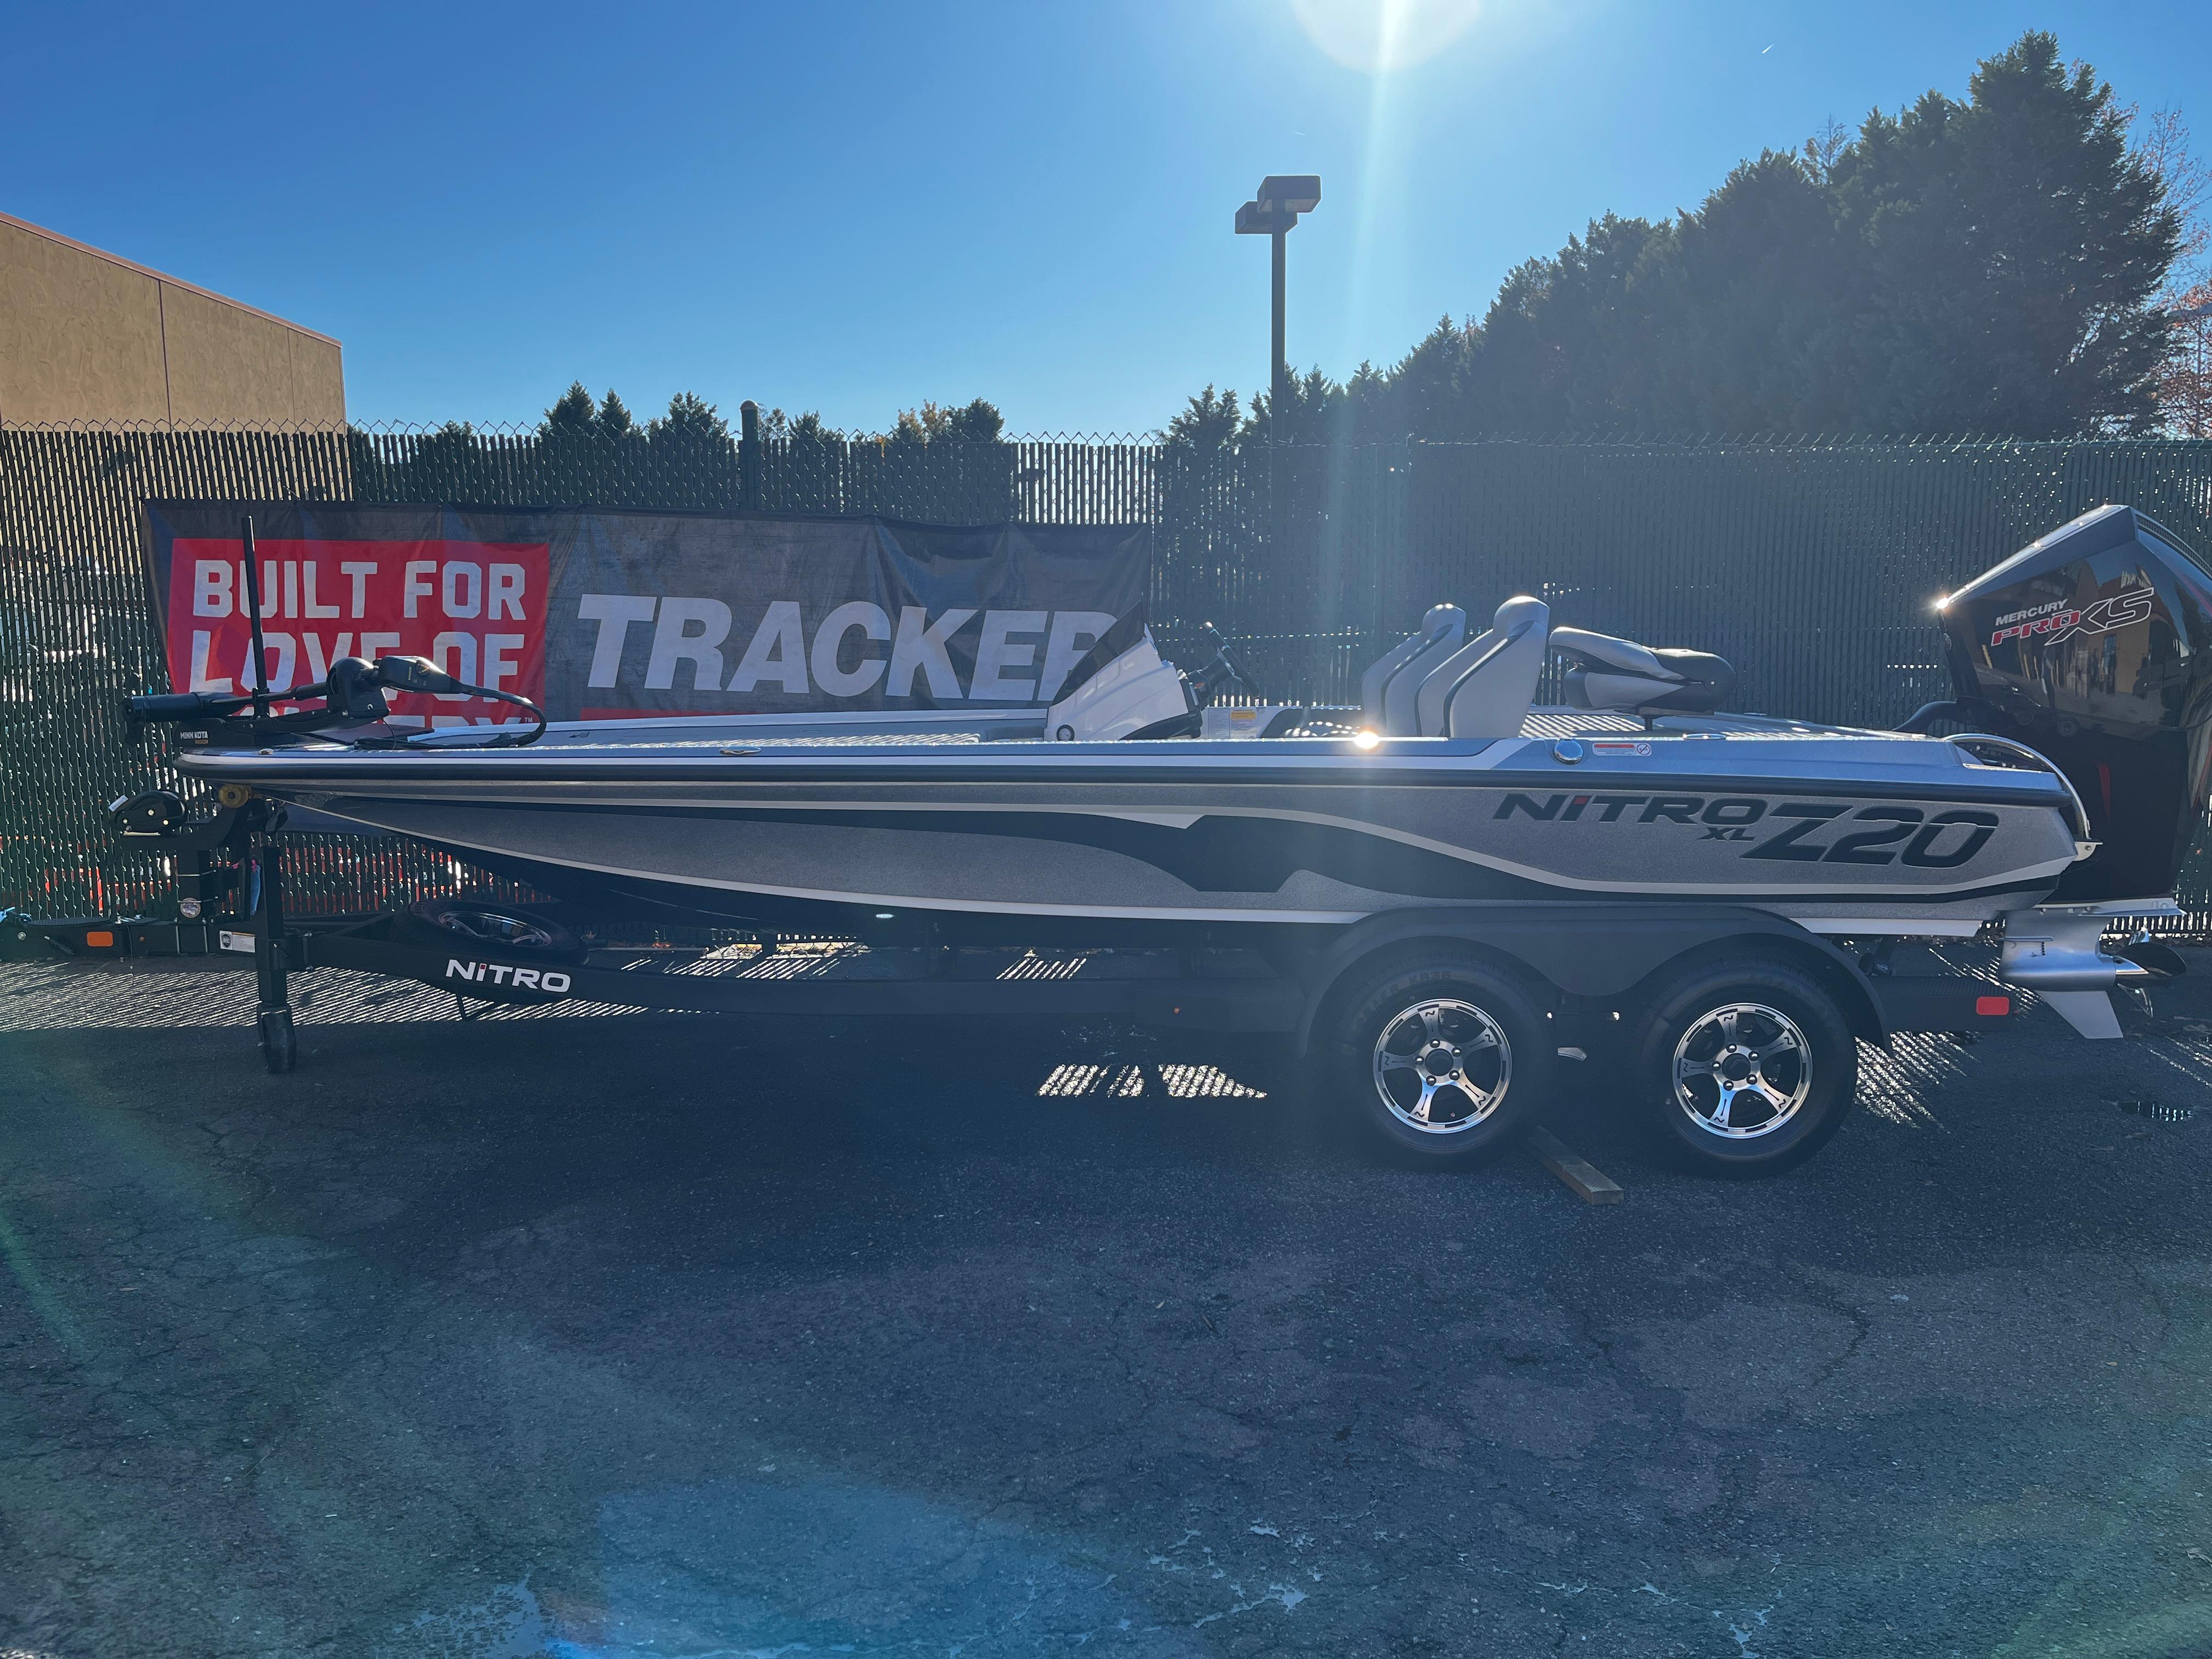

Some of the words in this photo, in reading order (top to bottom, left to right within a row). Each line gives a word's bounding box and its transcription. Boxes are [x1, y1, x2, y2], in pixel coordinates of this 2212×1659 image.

[193, 559, 378, 619] BUILT
[404, 560, 527, 620] FOR
[1995, 599, 2068, 626] MERCURY
[433, 631, 525, 703] OF
[1697, 826, 1757, 842] XL
[1738, 802, 1999, 868] Z20
